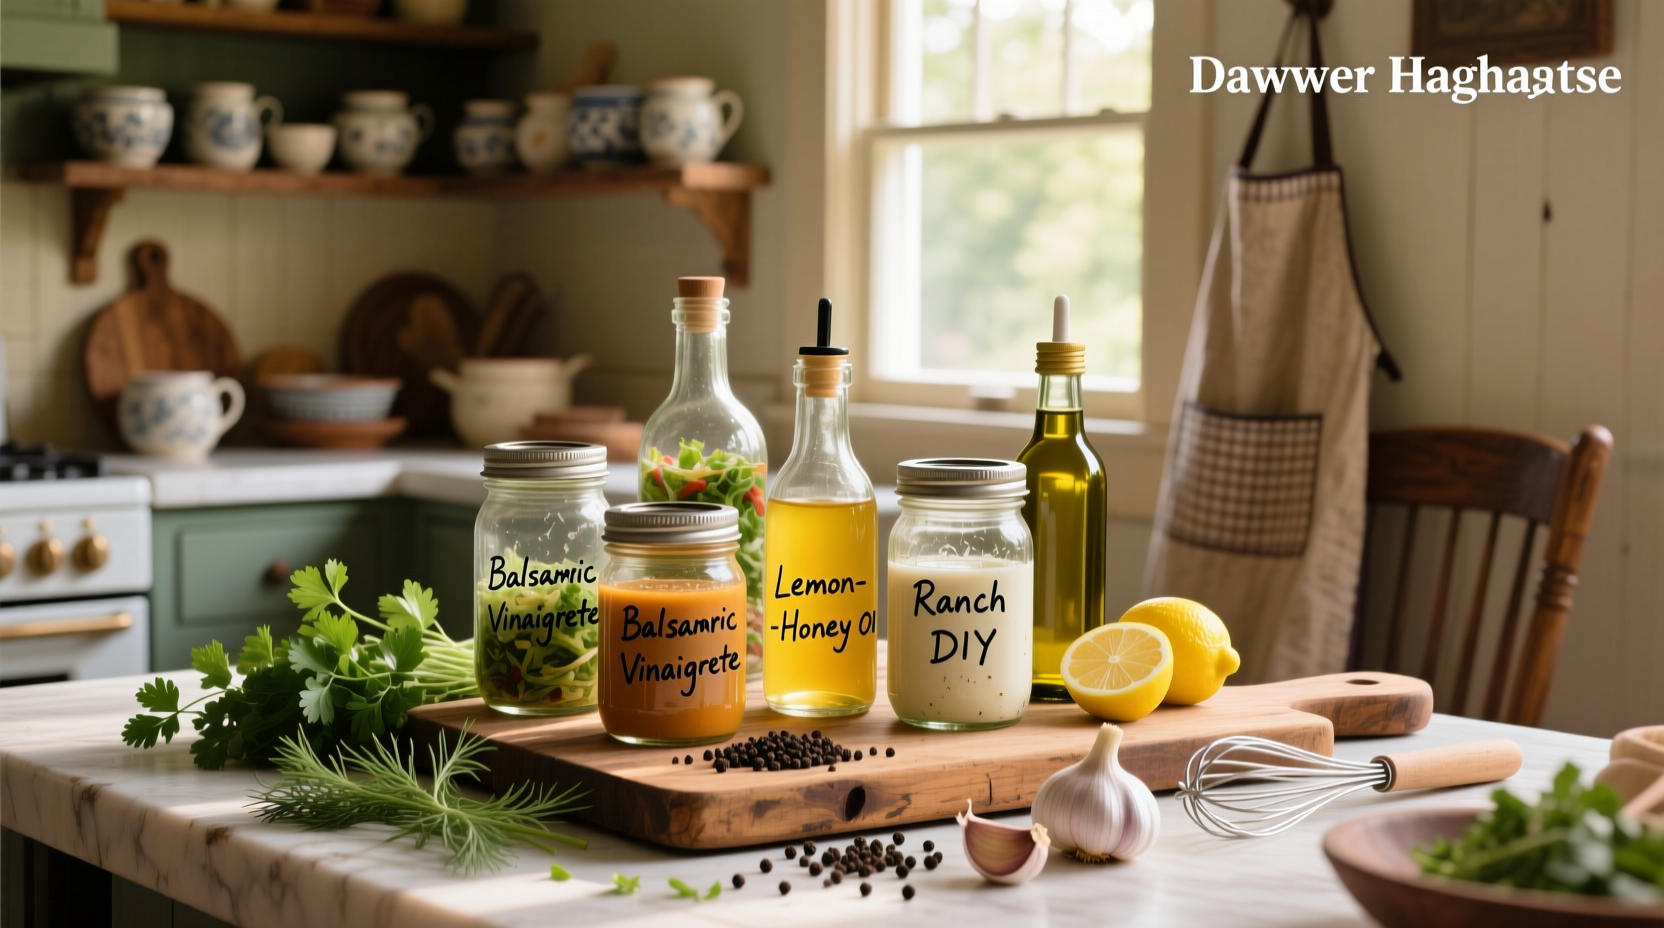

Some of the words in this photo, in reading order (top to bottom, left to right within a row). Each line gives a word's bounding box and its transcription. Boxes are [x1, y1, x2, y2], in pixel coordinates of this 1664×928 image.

[774, 564, 867, 599] Lemon-
[913, 579, 1006, 617] Ranch
[488, 598, 600, 647] Vinaigrete
[770, 608, 852, 654] -Honey
[930, 628, 997, 666] DIY
[620, 644, 741, 697] Vinaigrete
